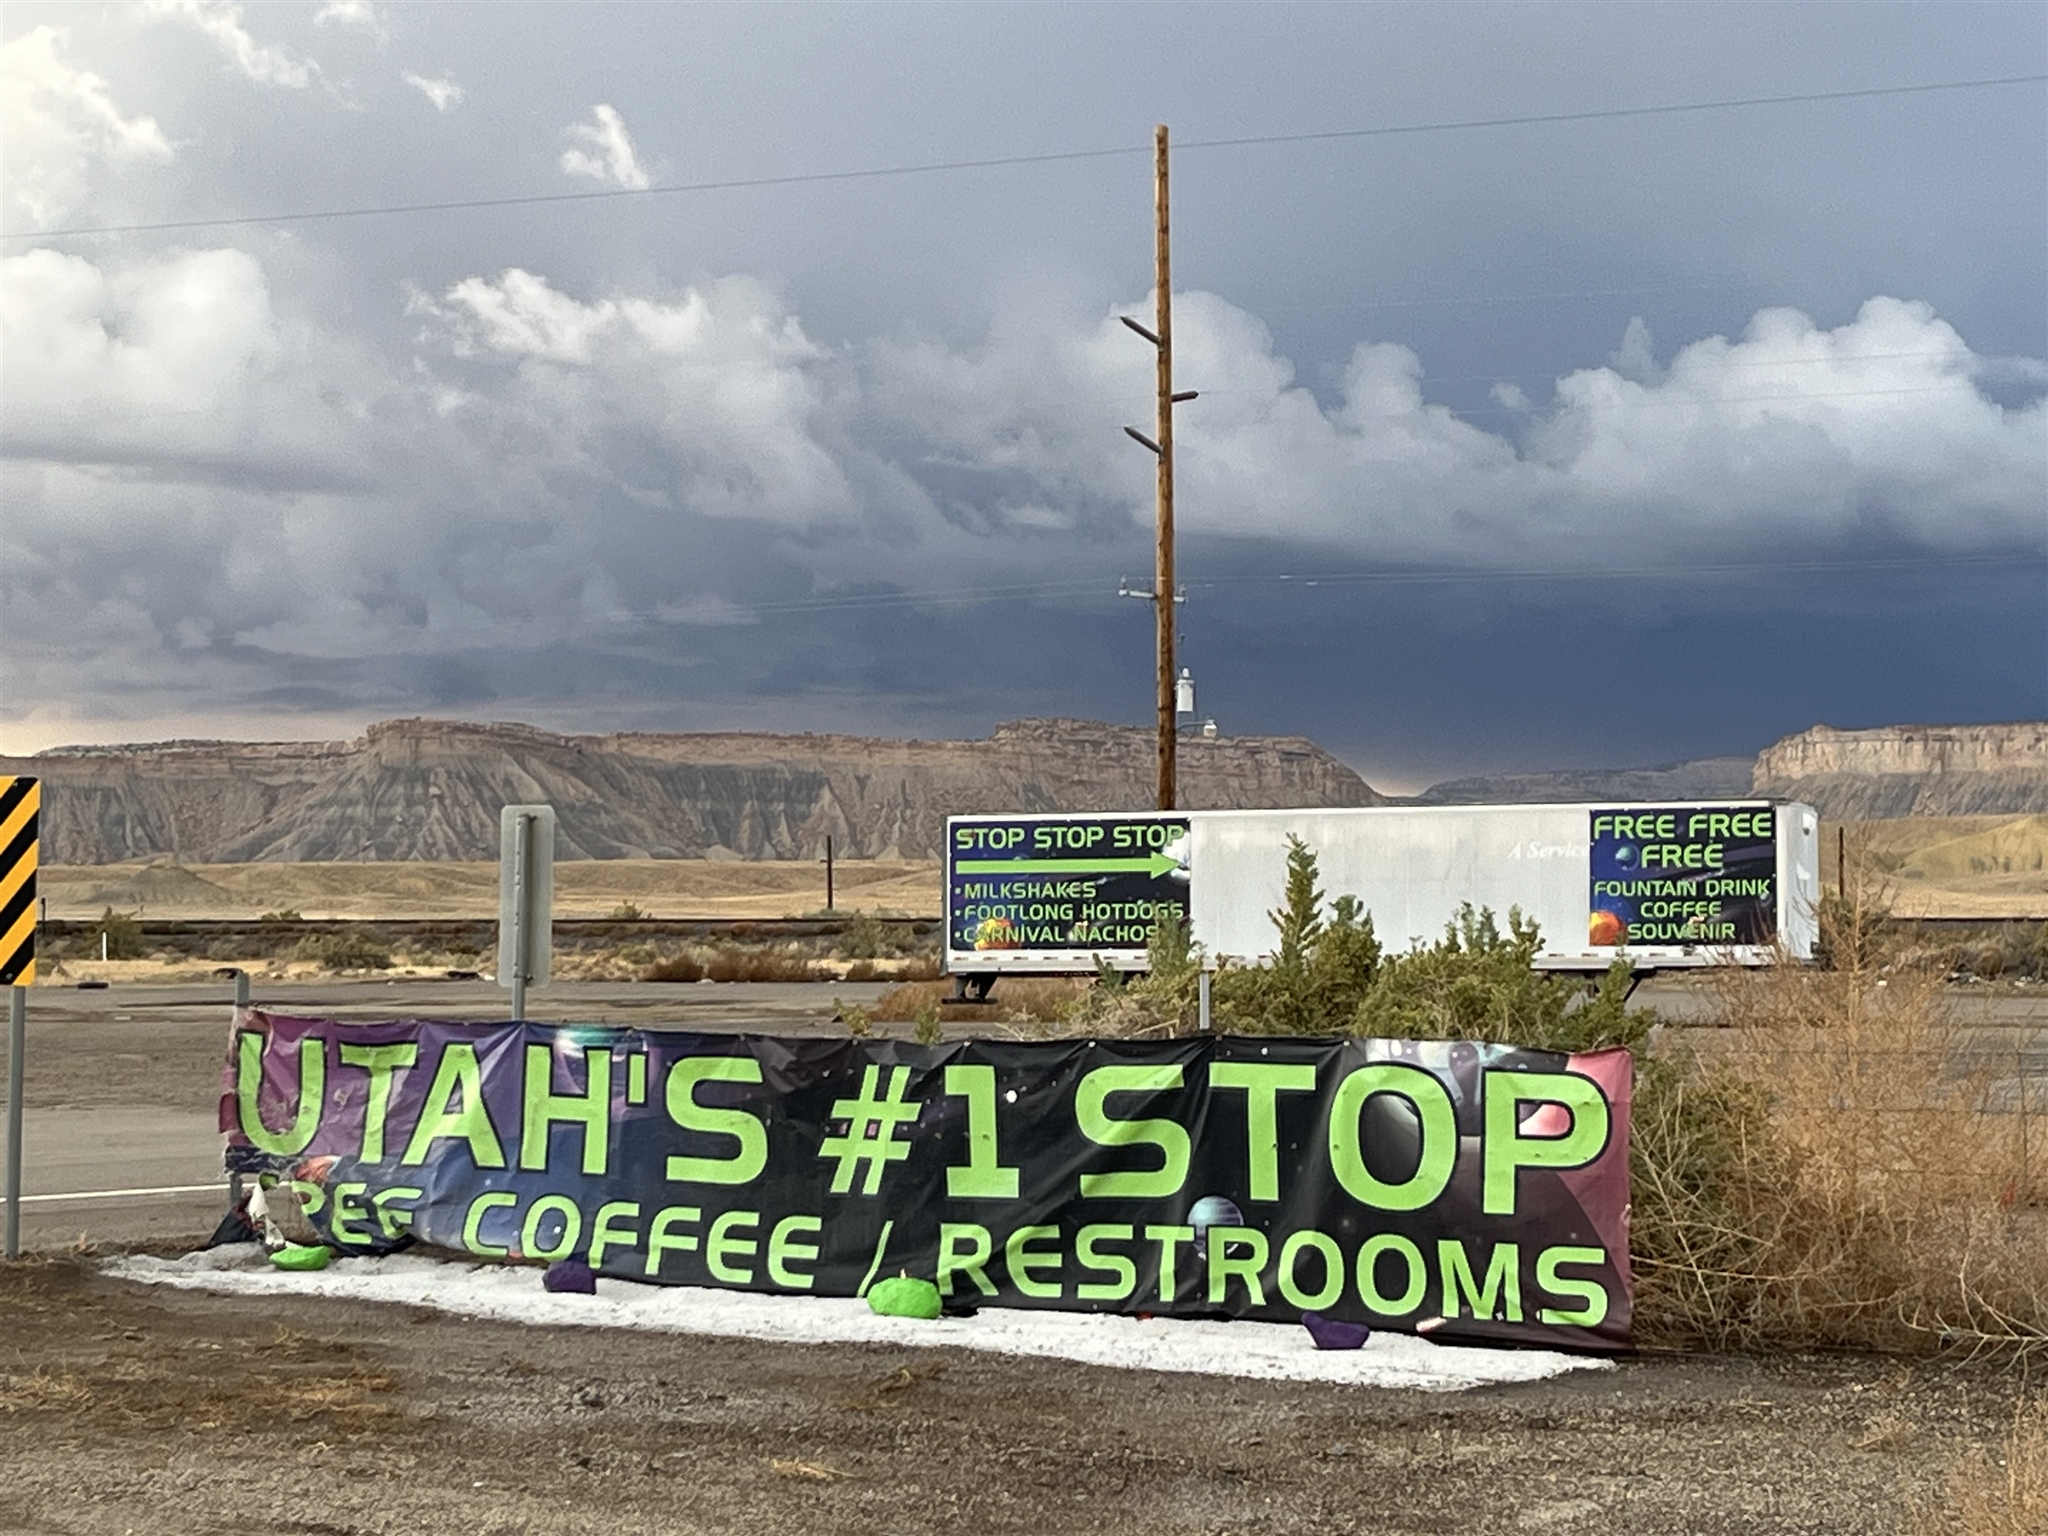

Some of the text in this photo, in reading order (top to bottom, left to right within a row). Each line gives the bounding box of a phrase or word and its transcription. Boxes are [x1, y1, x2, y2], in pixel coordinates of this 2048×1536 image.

[1594, 812, 1772, 839] FREE FREE
[956, 825, 1185, 849] STOP STOP STOP
[1507, 842, 1522, 859] A
[1641, 844, 1723, 868] FREE
[964, 882, 1097, 899] MILKSHAKES
[1594, 878, 1770, 897] FOUNTAIN DRINK
[964, 903, 1184, 921] FOOTLONG HOTDOGS
[1640, 901, 1722, 917] COFFEE
[964, 925, 1065, 943] CARNIVAL
[1627, 922, 1735, 940] SOUVENIR
[236, 1030, 1611, 1216] UTAH'S #1 STOP
[462, 1191, 823, 1290] COFFEE
[937, 1221, 1609, 1329] RESTROOMS
